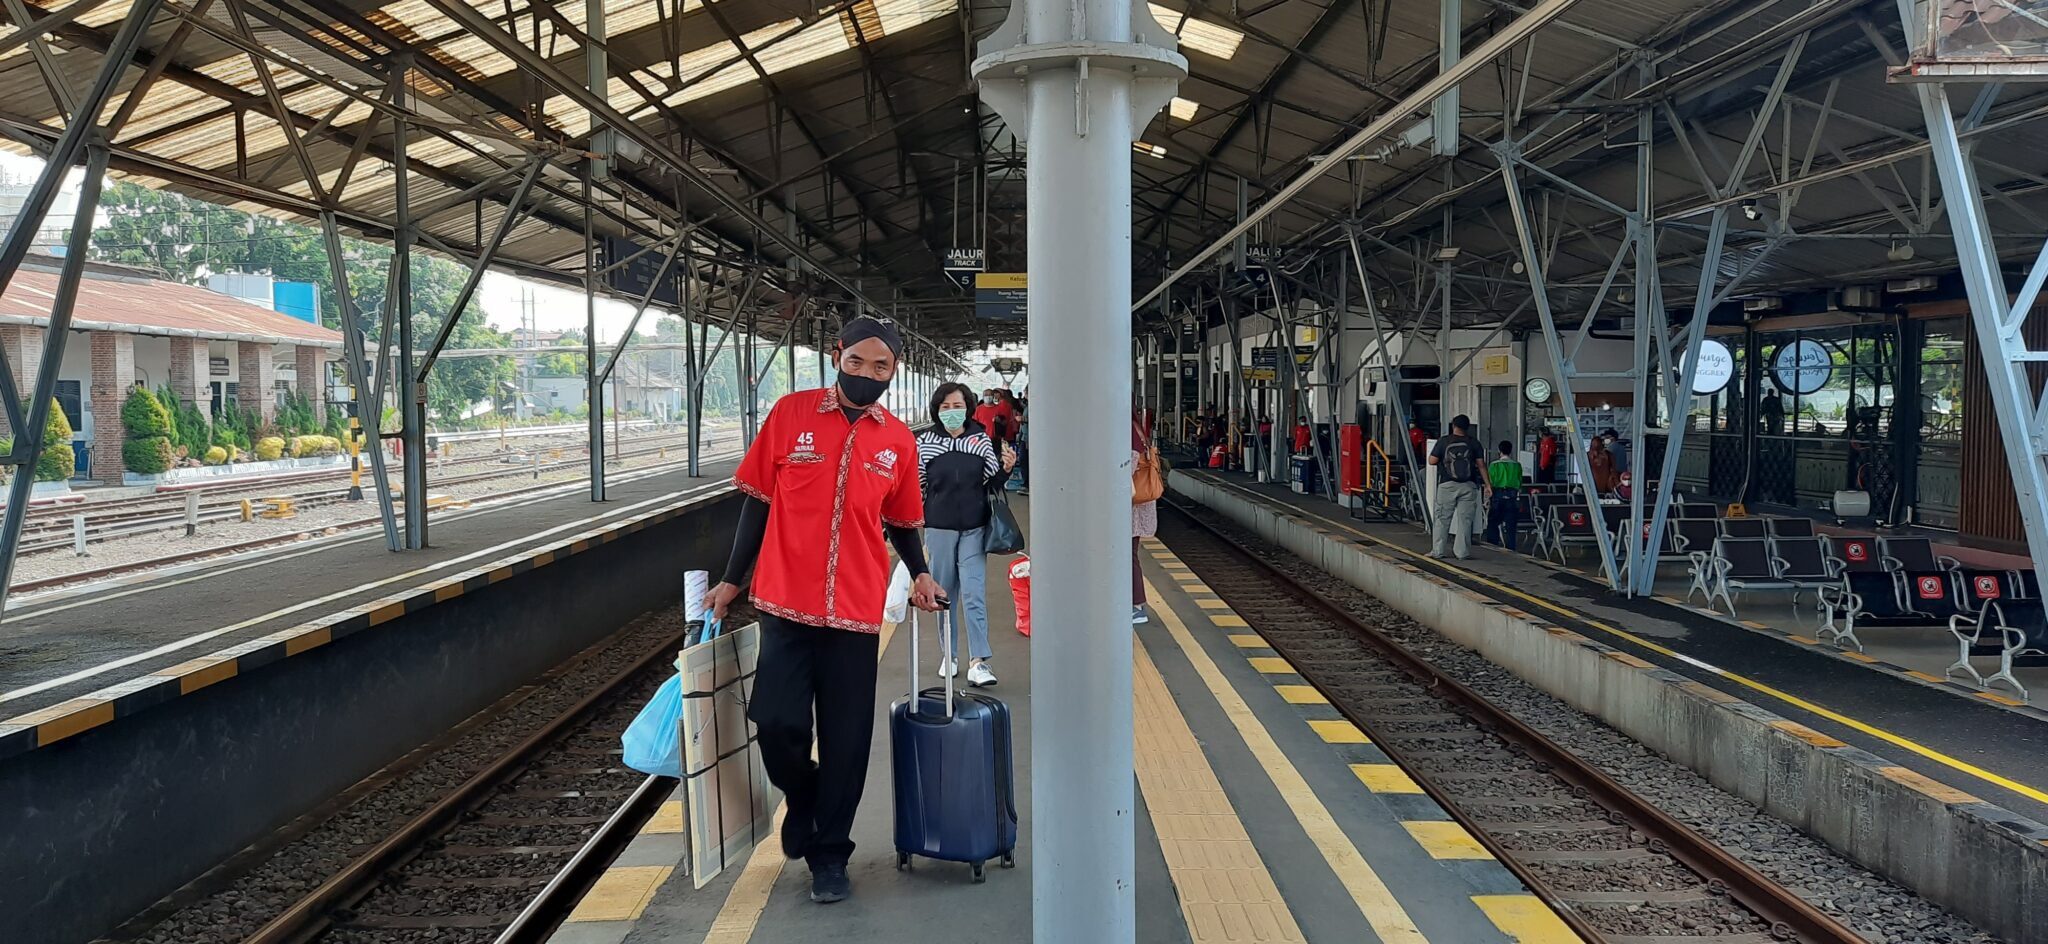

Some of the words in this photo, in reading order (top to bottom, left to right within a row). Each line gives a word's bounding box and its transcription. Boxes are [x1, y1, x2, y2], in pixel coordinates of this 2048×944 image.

[947, 249, 983, 259] JALUR
[961, 276, 970, 285] 5
[1256, 273, 1266, 282] 4
[797, 431, 814, 445] 45
